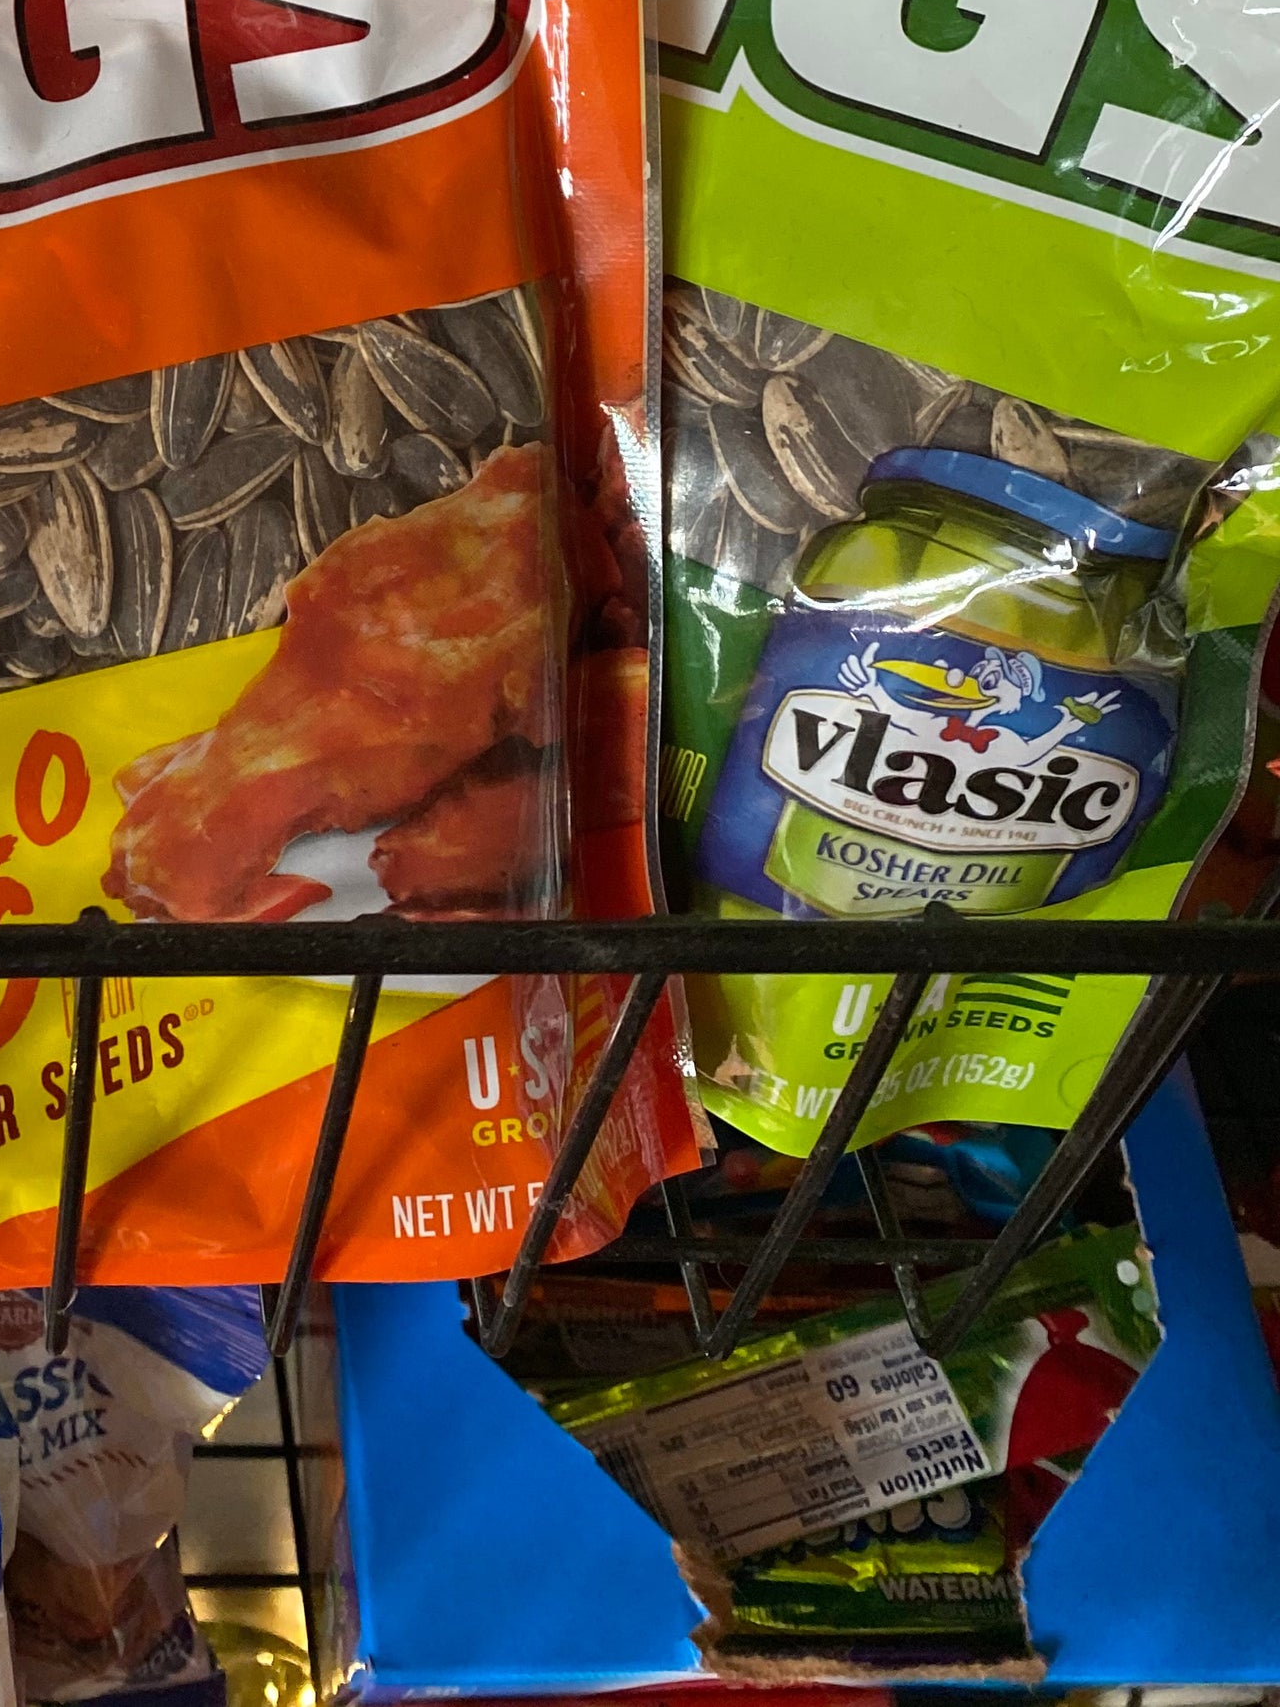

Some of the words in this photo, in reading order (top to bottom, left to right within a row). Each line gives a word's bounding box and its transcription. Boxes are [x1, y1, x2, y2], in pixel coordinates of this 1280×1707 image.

[816, 832, 950, 884] KOSHER
[853, 882, 972, 902] SPEARS
[945, 1010, 1056, 1039] SEEDS
[42, 1013, 184, 1121] SEDS
[942, 1053, 1035, 1091] (152g)
[392, 1194, 453, 1238] NET
[464, 1185, 515, 1234] WT
[824, 1372, 861, 1404] 60
[870, 1363, 938, 1397] Calories
[41, 1408, 106, 1460] MIX
[906, 1431, 973, 1464] Facts
[878, 1450, 984, 1498] Nutrition
[878, 1574, 1020, 1600] WATERM
